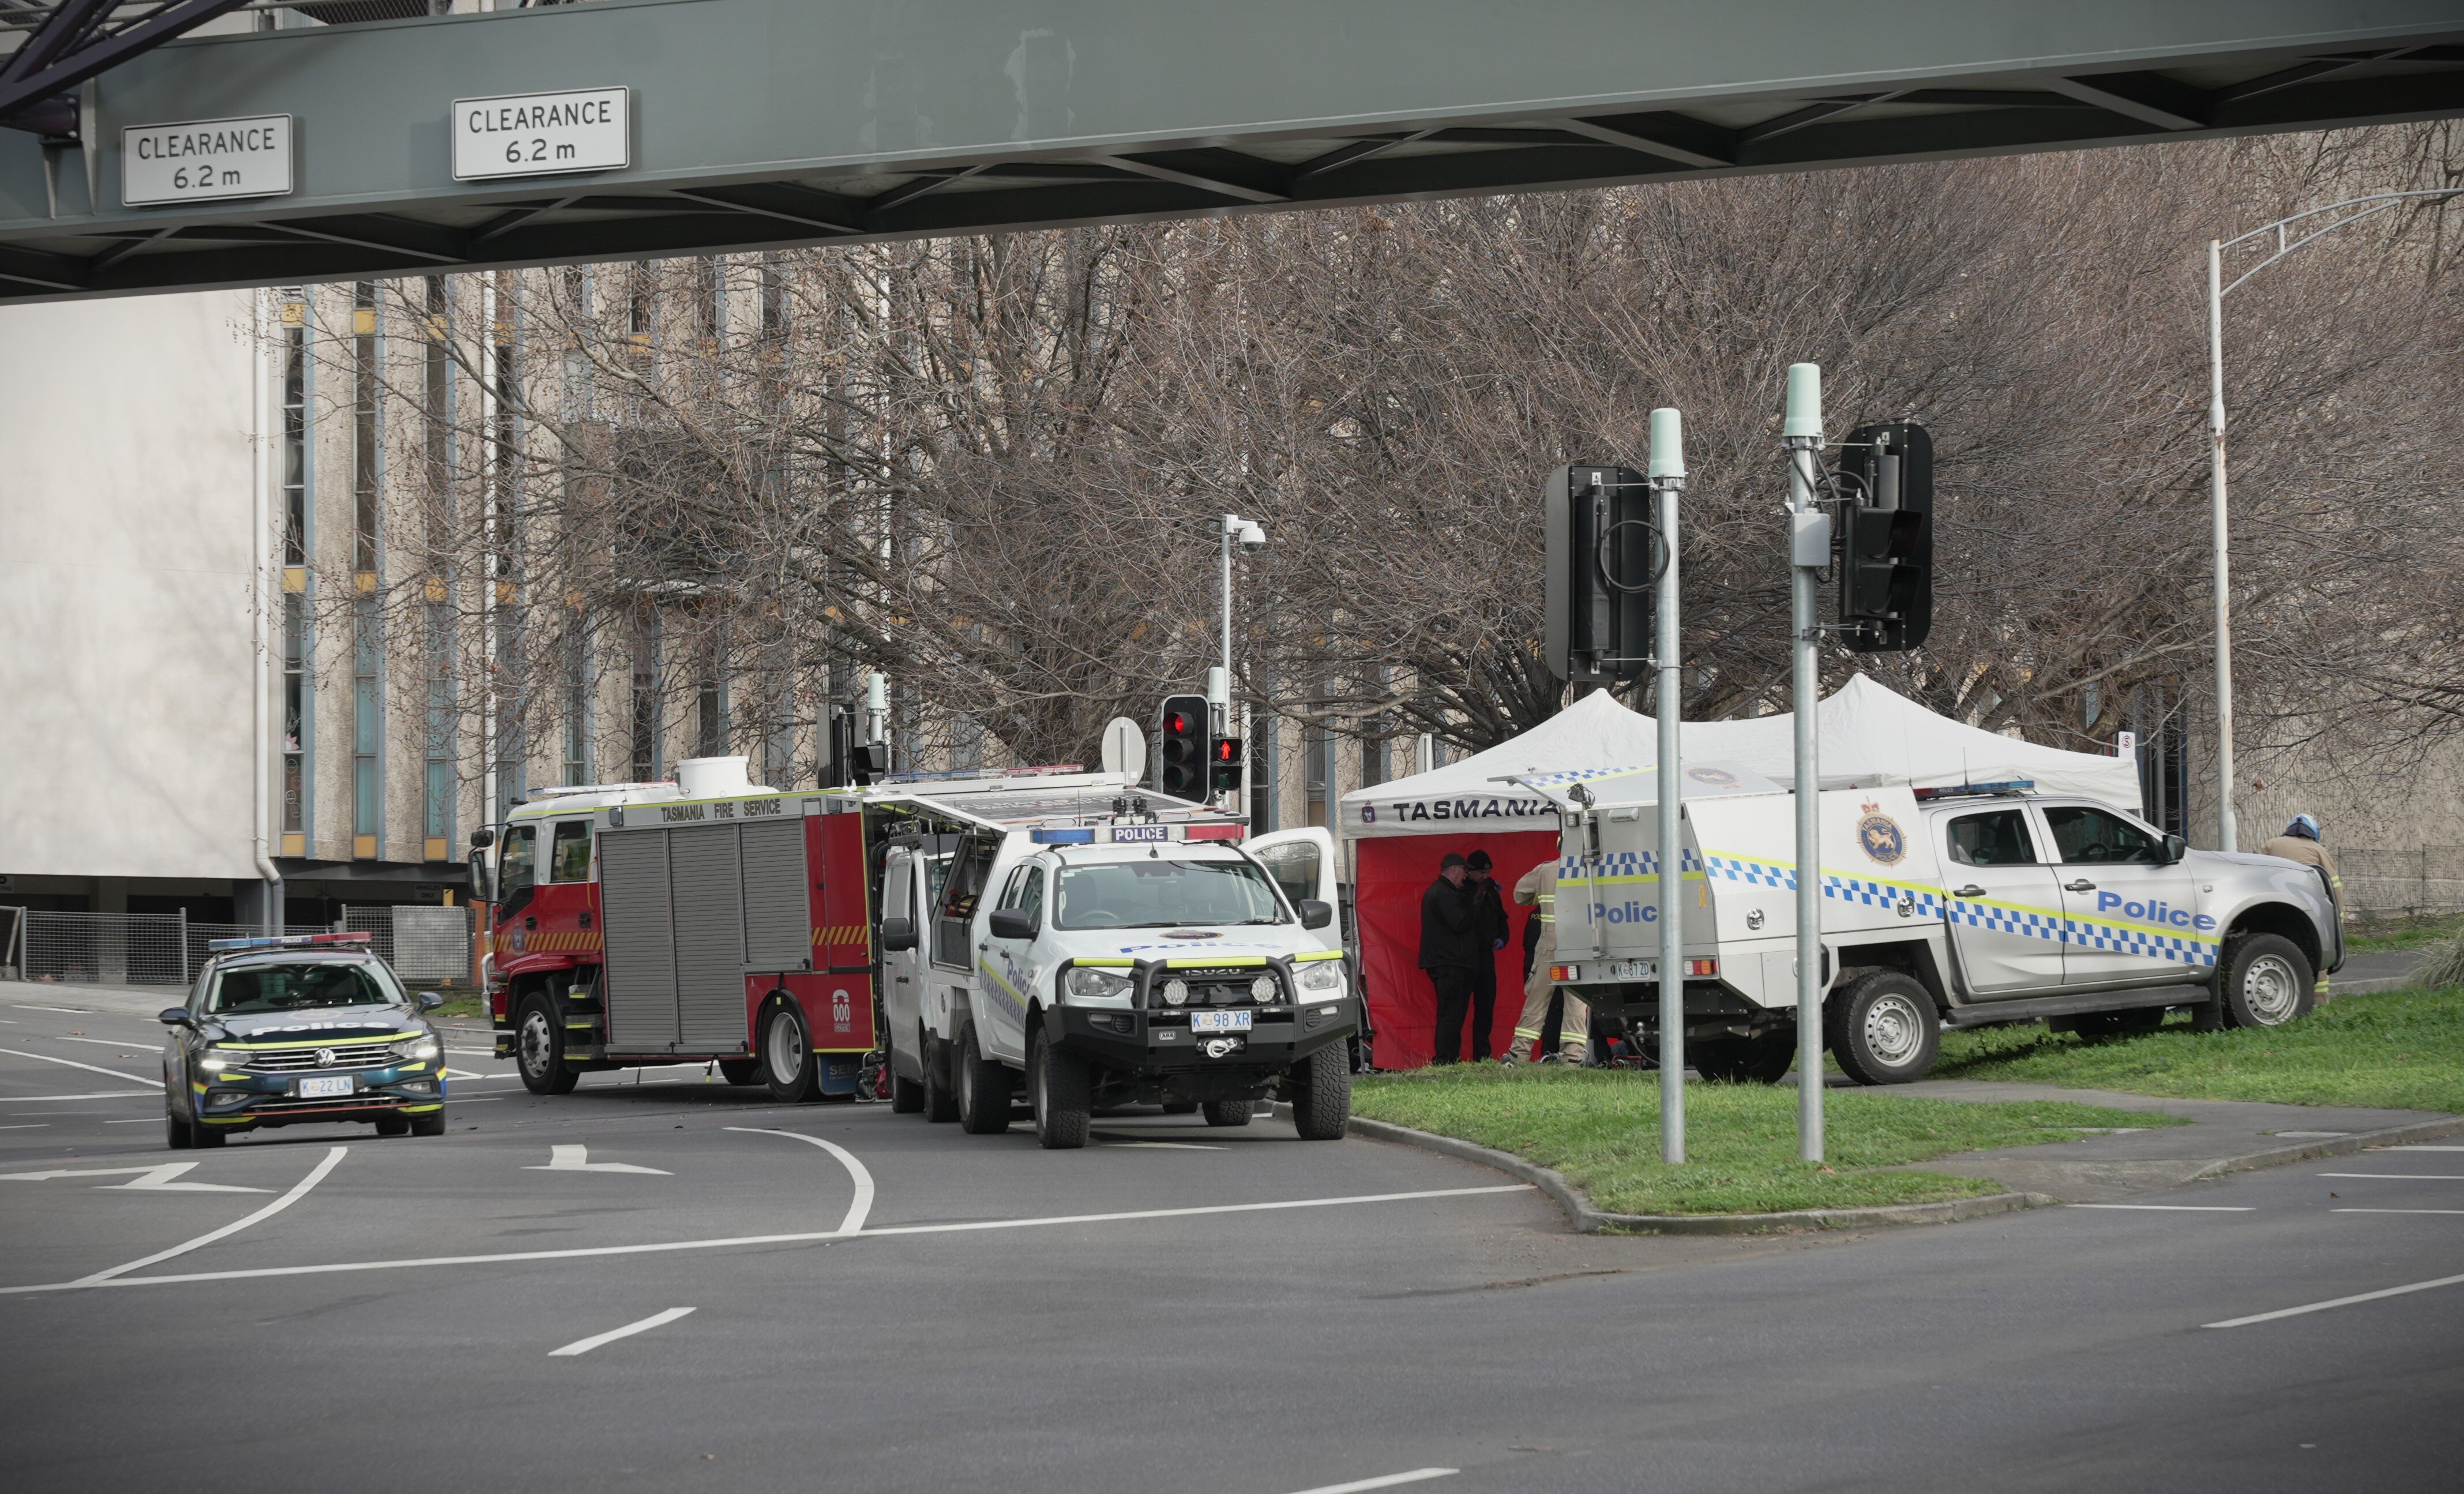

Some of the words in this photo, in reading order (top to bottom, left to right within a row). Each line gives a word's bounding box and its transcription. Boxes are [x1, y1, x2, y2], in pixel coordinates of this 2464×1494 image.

[469, 100, 611, 133] CLEARANCE
[139, 127, 275, 160] CLEARANCE
[506, 138, 547, 163] 6.2
[557, 144, 574, 159] m
[174, 165, 213, 189] 6.2
[223, 170, 241, 185] m
[661, 805, 705, 822] TASMANIA
[714, 802, 734, 819] FIRE
[743, 798, 781, 816] SERVICE
[1393, 799, 1560, 821] TASMANIA
[1115, 828, 1164, 840] POLICE
[1862, 817, 1893, 832] TASMANIA
[1876, 851, 1899, 862] POLICE
[1587, 901, 1658, 925] Polic
[2098, 891, 2217, 930] Police
[1120, 942, 1283, 954] Police
[1007, 958, 1030, 996] Polic
[1618, 964, 1623, 977] K
[1629, 963, 1637, 976] 87
[1640, 962, 1649, 975] ZD
[833, 1003, 850, 1022] 000
[1193, 1014, 1200, 1027] K
[1214, 1013, 1229, 1027] 98
[1235, 1012, 1250, 1026] XR
[303, 1082, 309, 1093] K
[320, 1080, 333, 1092] 22
[337, 1079, 351, 1091] LN
